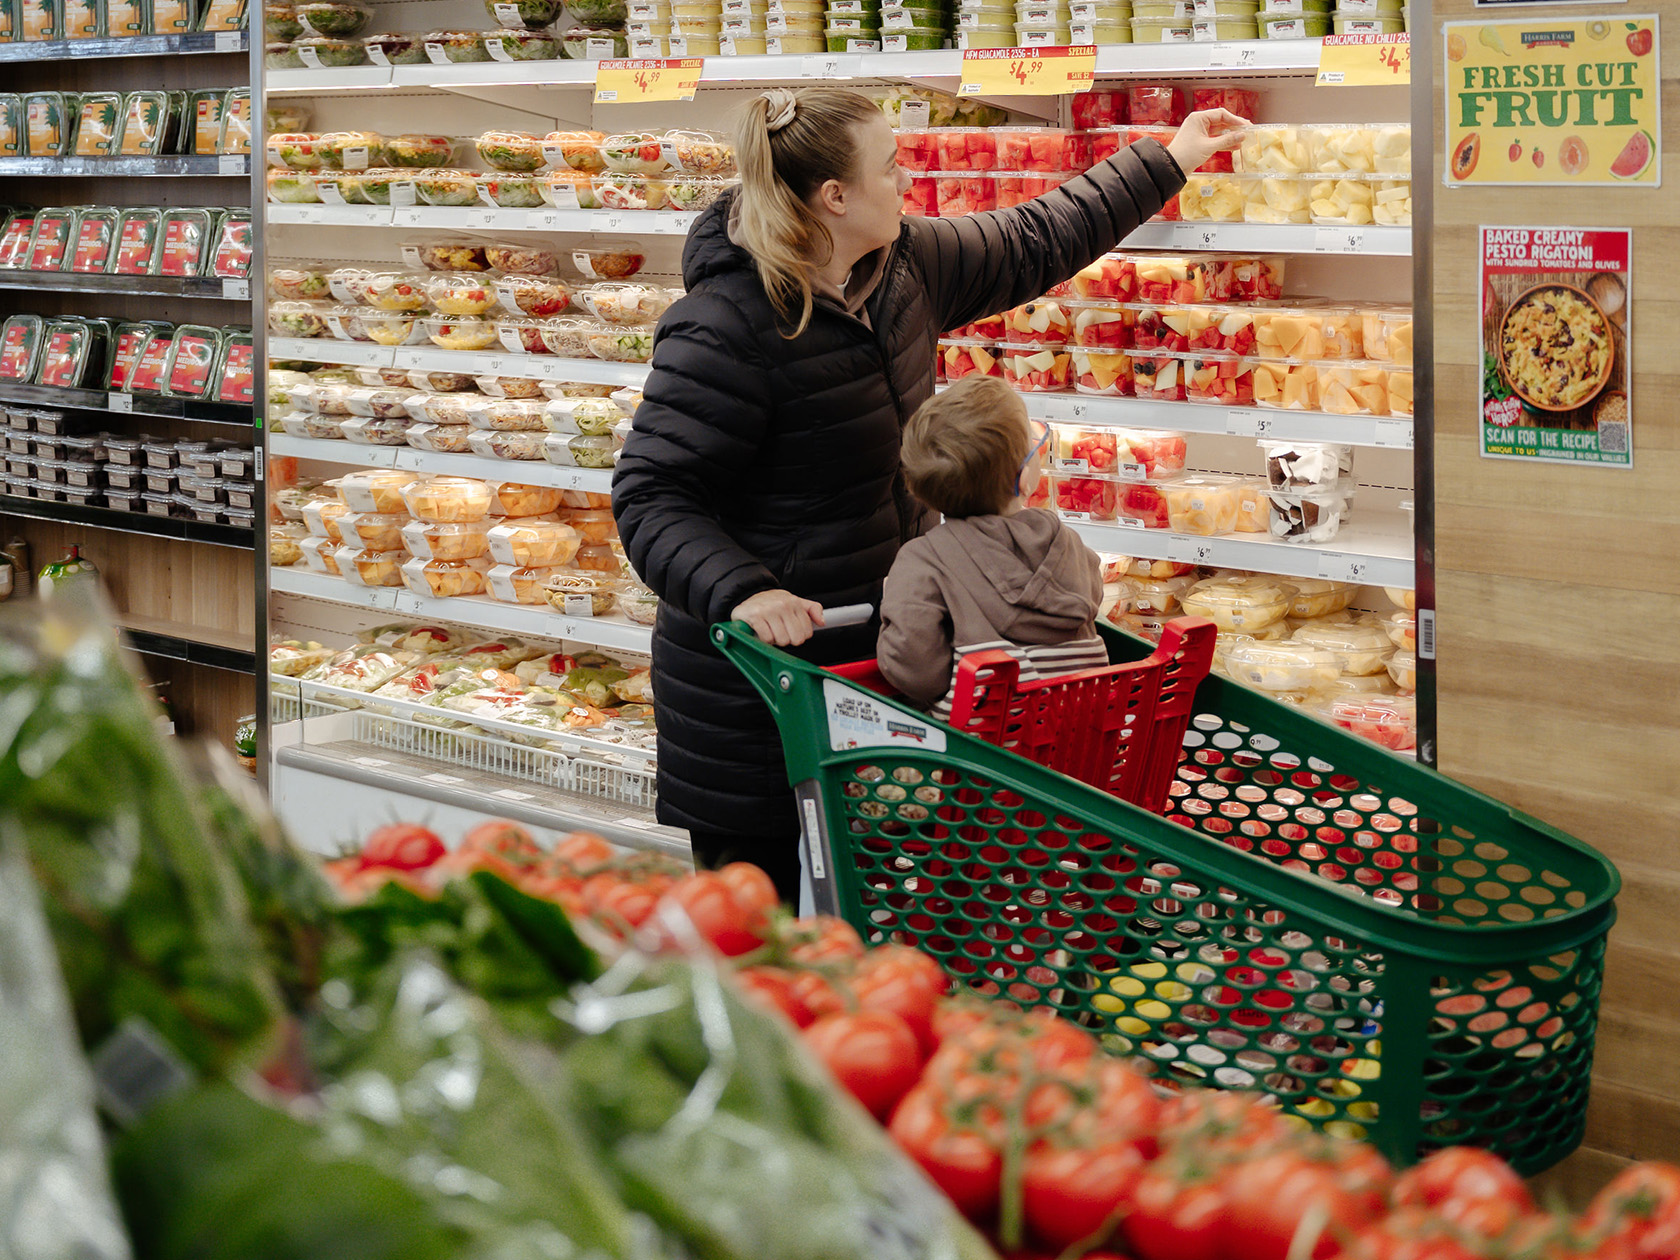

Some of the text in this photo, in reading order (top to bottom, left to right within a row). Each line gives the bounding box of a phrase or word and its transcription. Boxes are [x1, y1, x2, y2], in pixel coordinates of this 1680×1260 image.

[1325, 35, 1364, 45] GUACAMOLE
[1365, 35, 1375, 44] NO
[1376, 34, 1396, 44] CHILLI
[1551, 32, 1572, 41] FARM
[965, 50, 978, 60] HFM
[979, 49, 1010, 59] GUACAMOLE
[1031, 48, 1040, 58] EA
[1068, 46, 1094, 56] SPECIAL
[1009, 60, 1043, 86] $4.99
[1463, 62, 1638, 89] FRESH CUT
[633, 71, 660, 93] $4.99
[1458, 88, 1643, 127] FRUIT
[1485, 230, 1584, 246] BAKED CREAMY
[1485, 245, 1593, 260] PESTO RIGATONI
[1485, 258, 1620, 270] WITH SUNDRIED TOMATOES AND OLIVES
[1486, 428, 1598, 450] SCAN FOR THE RECIPE
[1487, 445, 1514, 456] UNIQUE
[1515, 447, 1524, 455] TO
[1525, 448, 1536, 456] US
